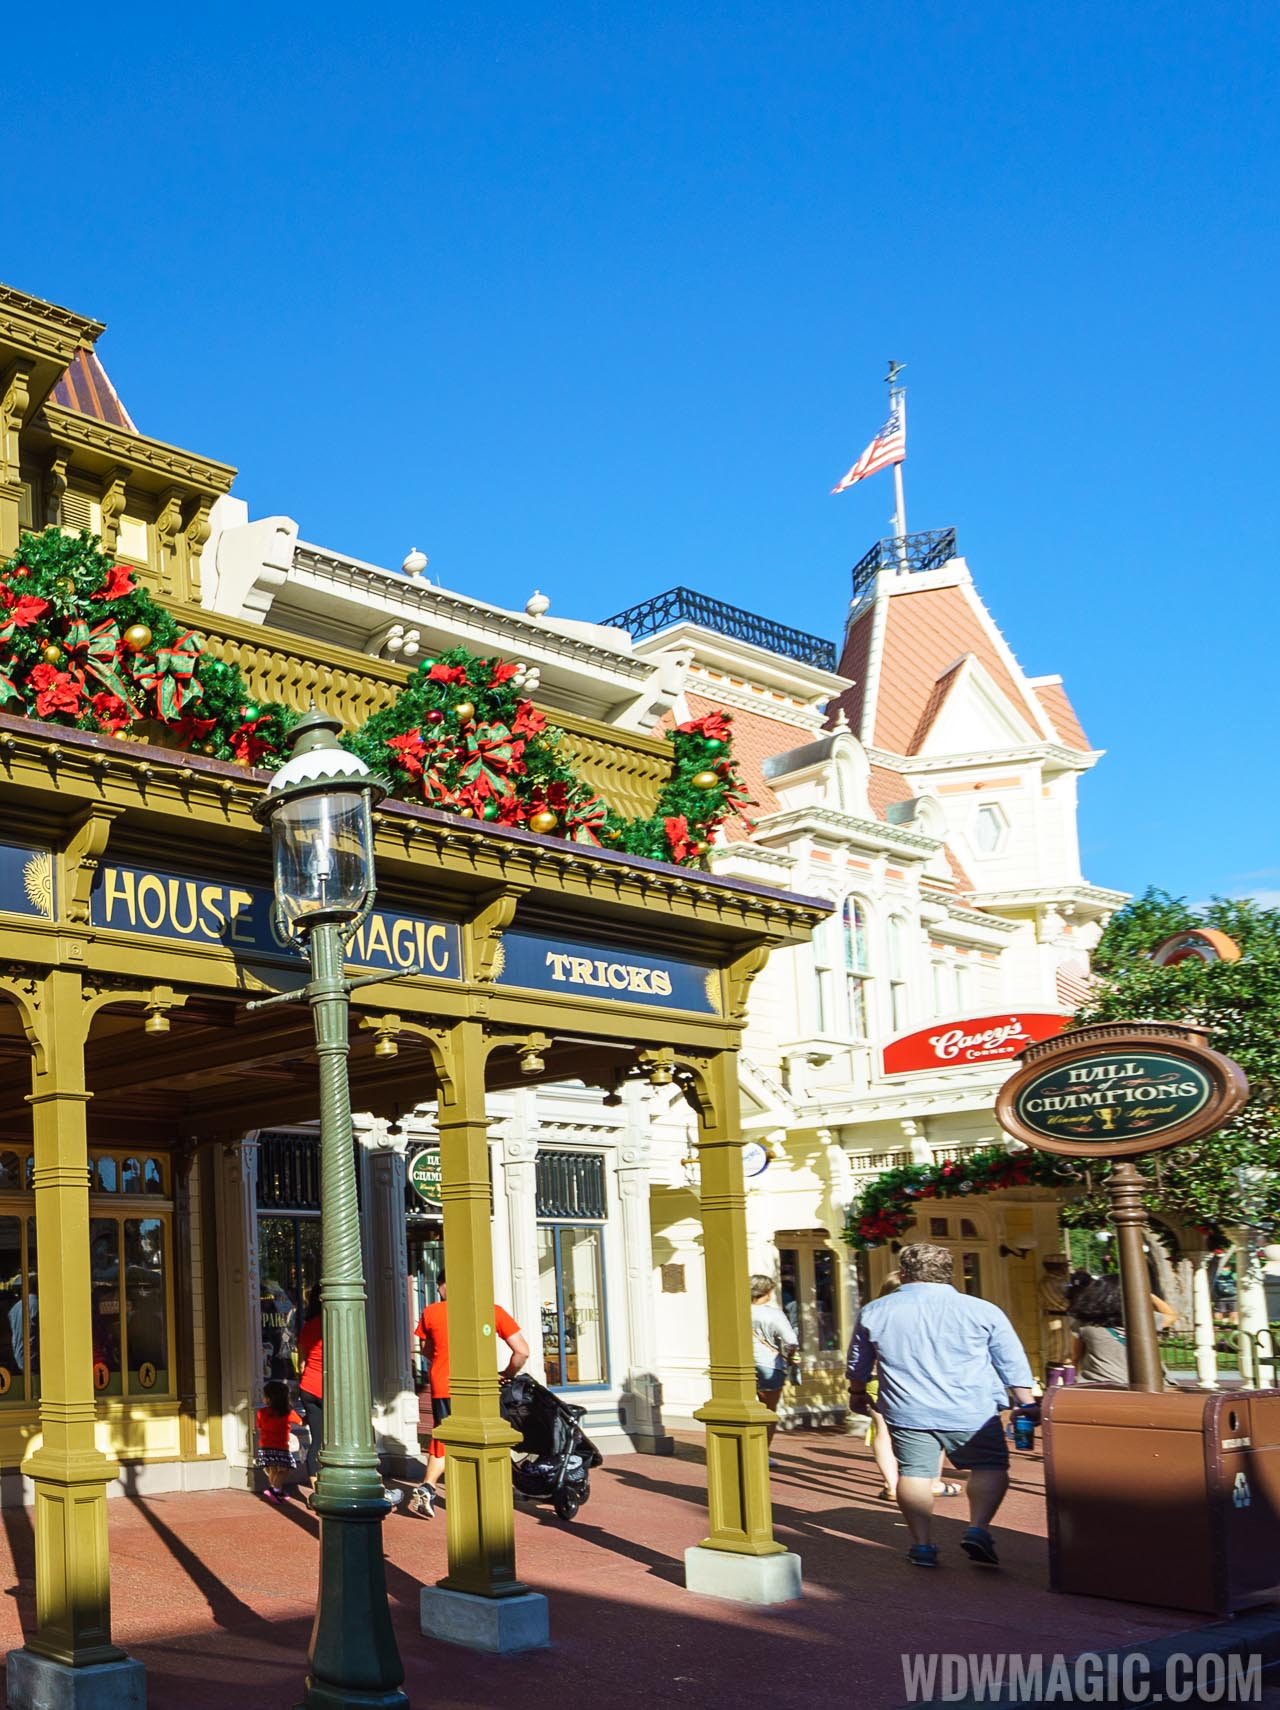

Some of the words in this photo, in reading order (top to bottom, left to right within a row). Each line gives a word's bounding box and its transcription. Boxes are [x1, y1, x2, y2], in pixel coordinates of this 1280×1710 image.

[104, 867, 256, 943] HOUSE
[545, 951, 673, 996] TRICKS
[928, 1017, 1031, 1059] Casey's
[1068, 1062, 1145, 1083] HALL
[1097, 1077, 1118, 1091] of
[1026, 1081, 1199, 1113] CHAMPIONS
